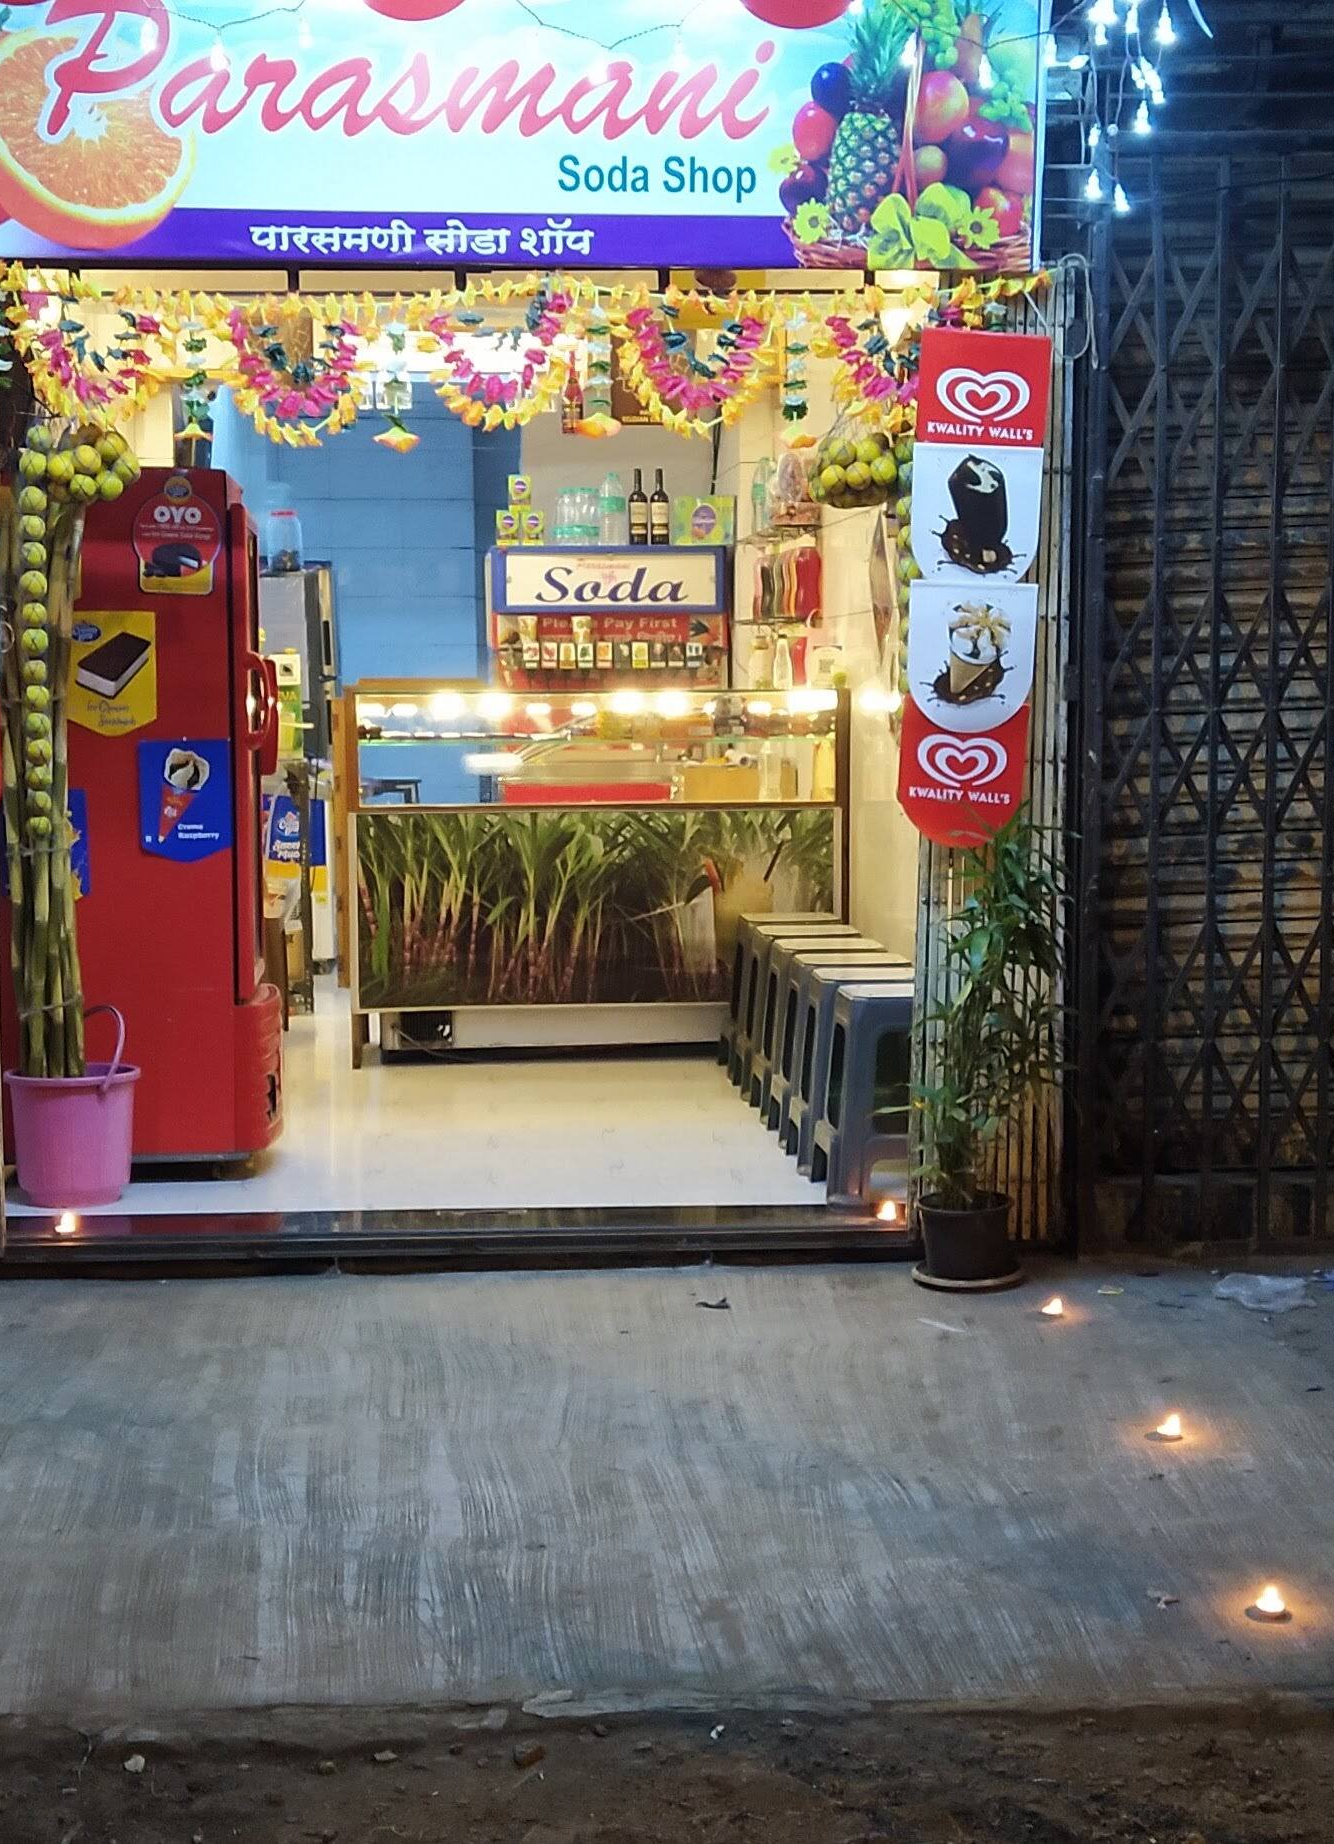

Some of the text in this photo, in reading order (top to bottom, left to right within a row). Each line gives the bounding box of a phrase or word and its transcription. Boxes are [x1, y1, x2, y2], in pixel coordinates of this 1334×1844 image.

[46, 0, 776, 139] Parasmani
[557, 155, 756, 202] Soda Shop
[249, 217, 594, 256] पारसमणी सोडा शॉप
[927, 421, 1033, 440] KWALITY WALL'S
[153, 505, 202, 525] OYO
[535, 566, 689, 603] Soda
[543, 617, 677, 631] Plee Pay First
[908, 786, 1010, 805] KWALITY WALL'S
